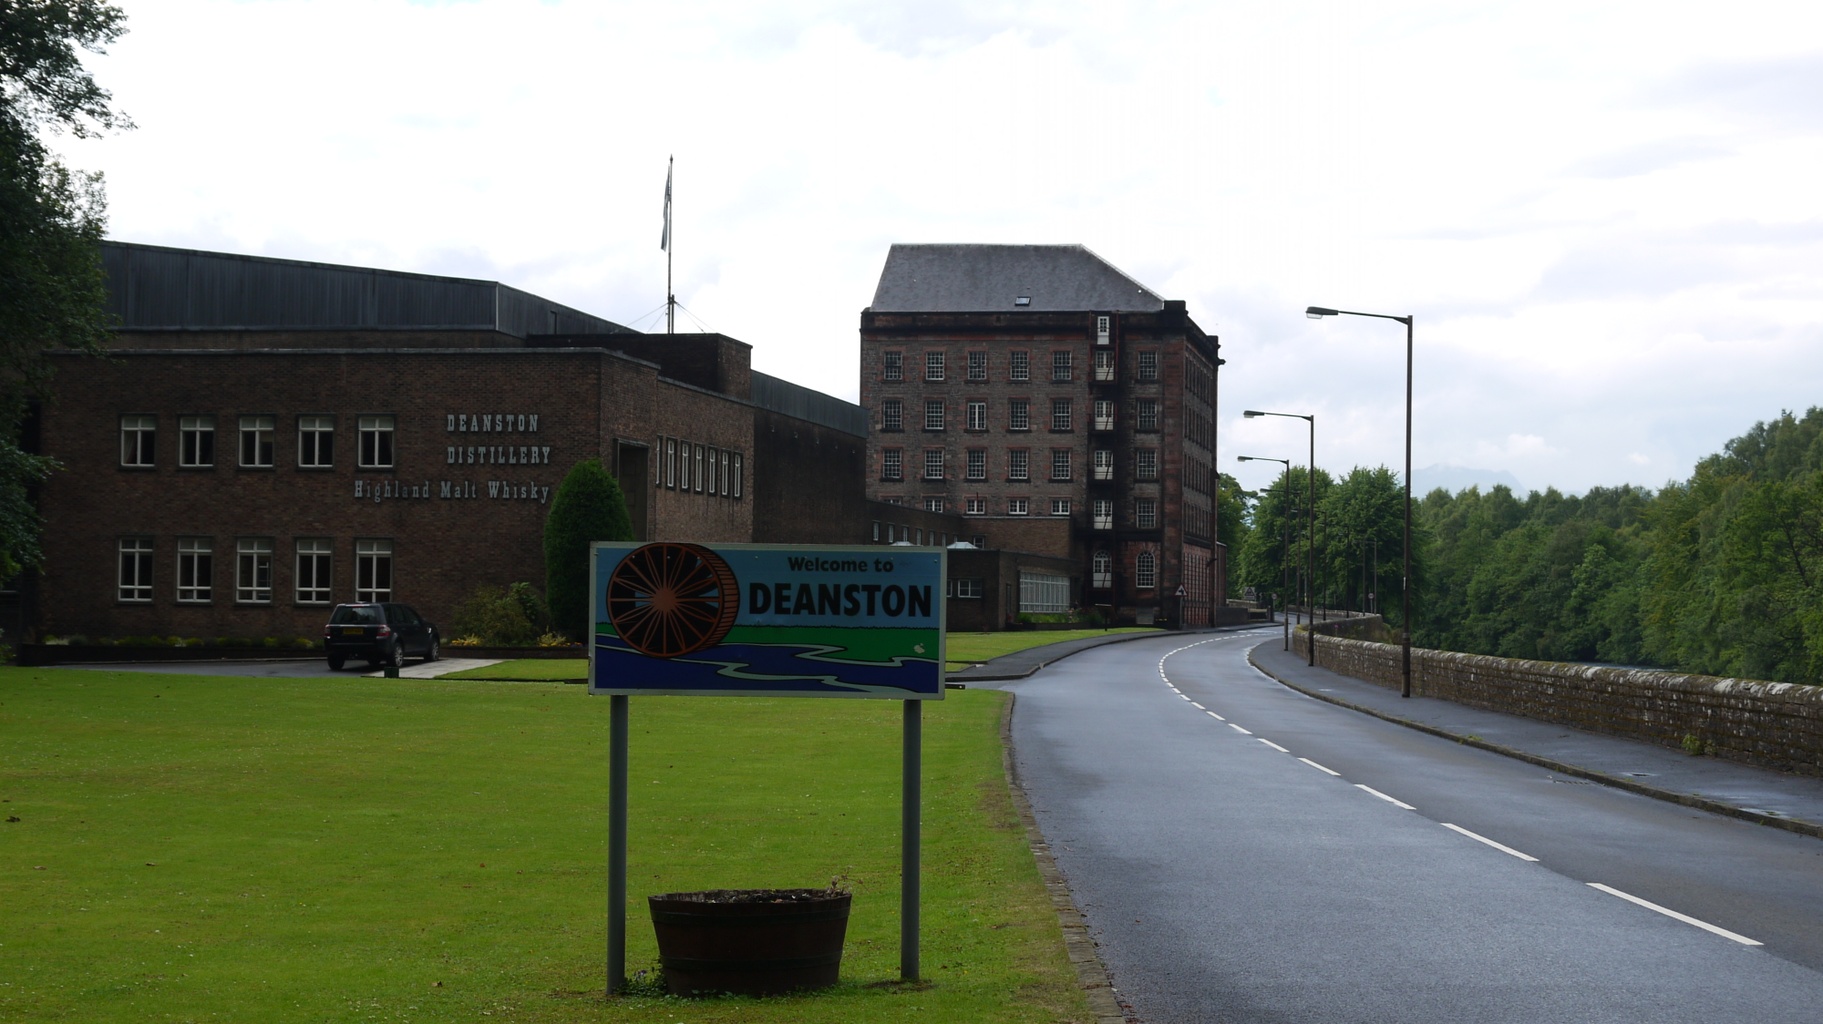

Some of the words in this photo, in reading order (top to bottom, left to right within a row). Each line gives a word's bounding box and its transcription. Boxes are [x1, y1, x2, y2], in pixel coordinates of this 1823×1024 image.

[447, 414, 538, 432] DEANSTON
[447, 446, 550, 464] DISTILLERY
[354, 480, 430, 503] Highland
[440, 480, 477, 499] Malt
[488, 480, 549, 504] Whisky
[787, 557, 868, 572] Welcome
[873, 557, 894, 572] to
[750, 582, 932, 617] DEANSTON
